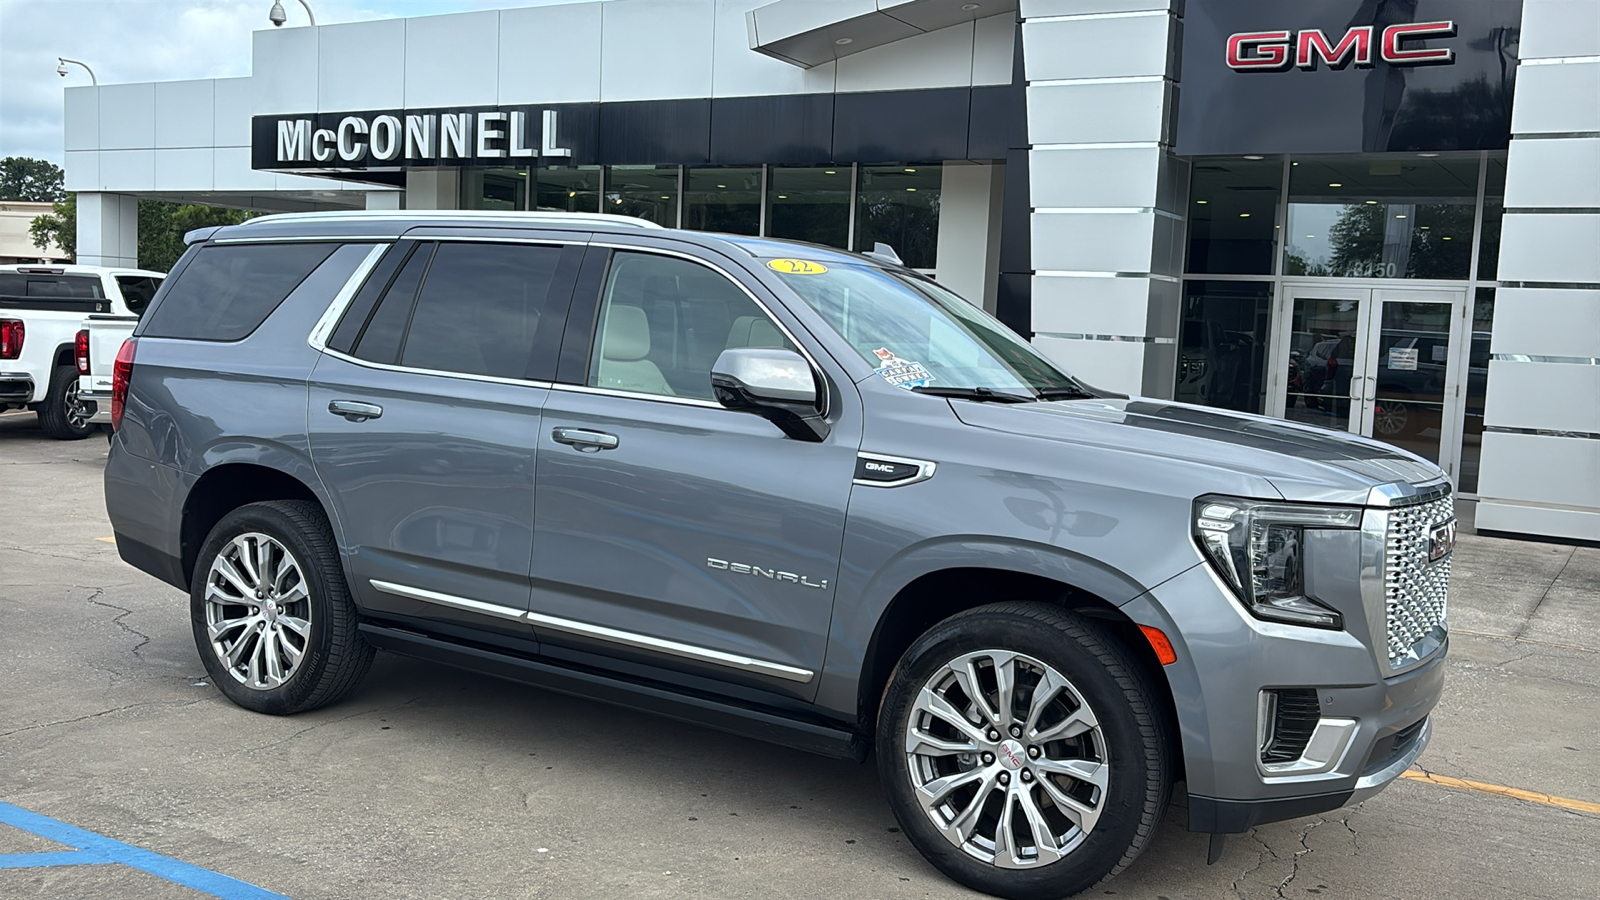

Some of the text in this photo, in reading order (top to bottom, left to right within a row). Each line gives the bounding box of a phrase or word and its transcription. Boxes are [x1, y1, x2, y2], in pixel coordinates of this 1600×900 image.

[1226, 20, 1455, 70] GMC
[277, 110, 571, 162] McCONNELL
[784, 260, 812, 272] 22
[880, 364, 923, 378] CARFAX
[865, 462, 894, 473] GMC
[707, 557, 827, 590] DENALI
[1001, 743, 1022, 768] GMC
